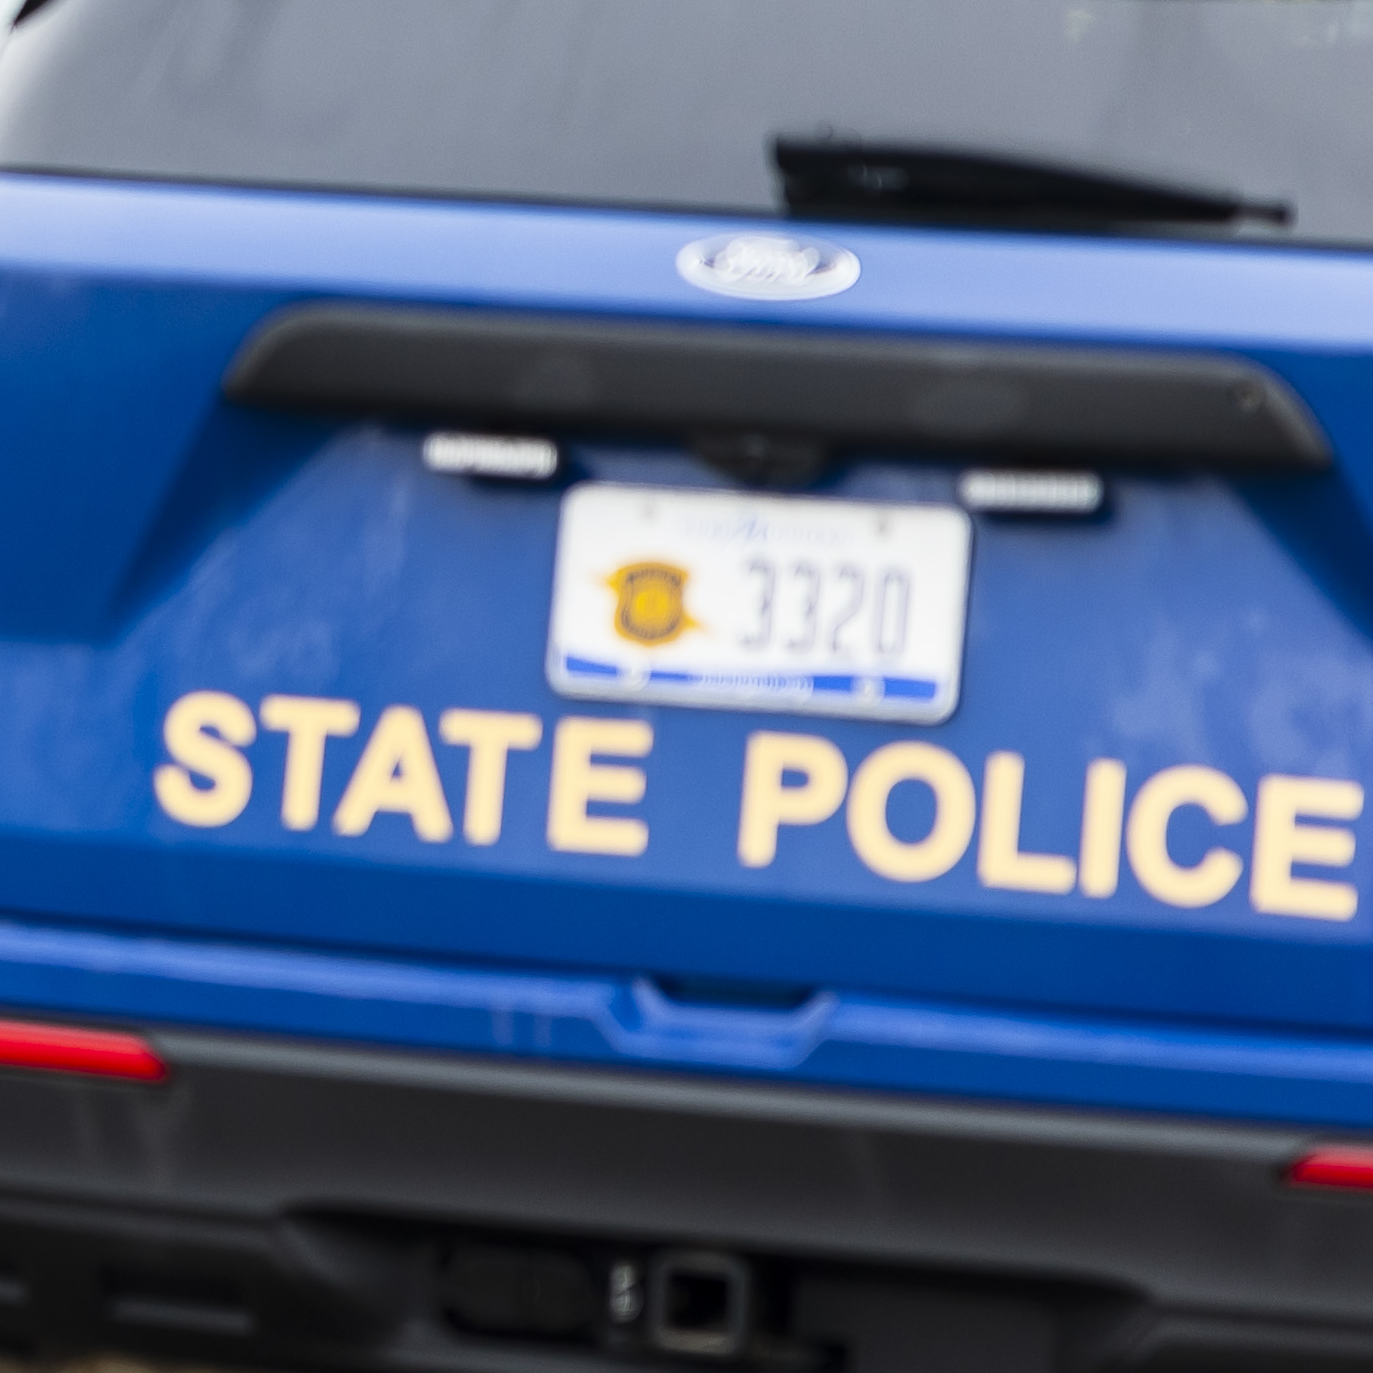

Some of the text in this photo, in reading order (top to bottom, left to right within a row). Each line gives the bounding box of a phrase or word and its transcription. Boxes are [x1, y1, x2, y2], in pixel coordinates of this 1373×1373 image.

[736, 555, 914, 659] 3320
[152, 689, 1365, 921] STATE POLICE
